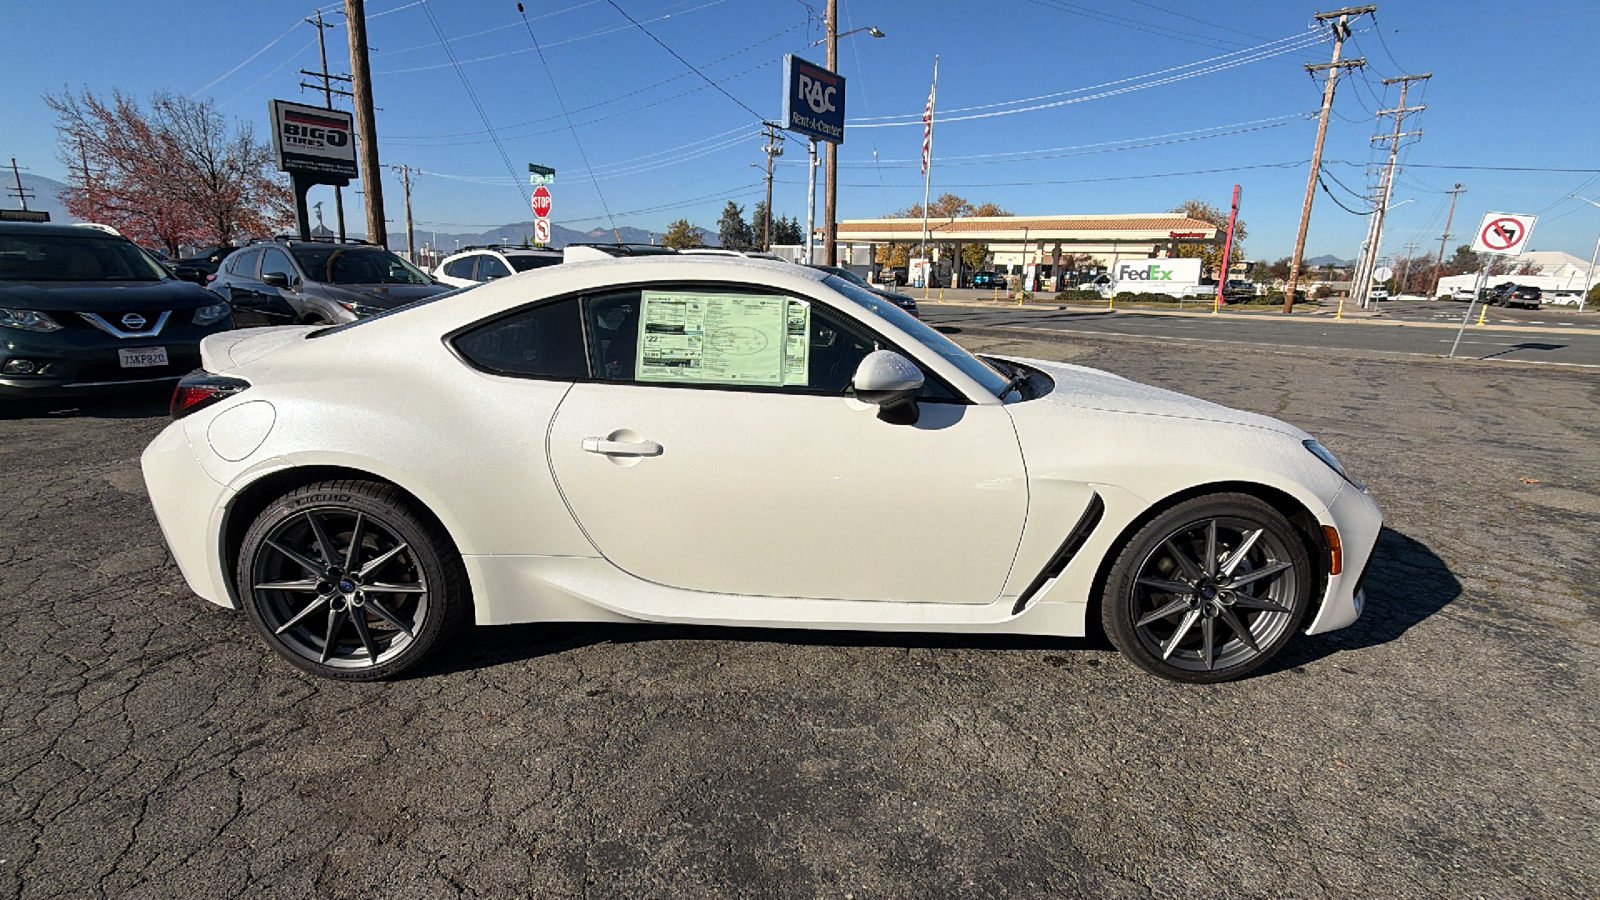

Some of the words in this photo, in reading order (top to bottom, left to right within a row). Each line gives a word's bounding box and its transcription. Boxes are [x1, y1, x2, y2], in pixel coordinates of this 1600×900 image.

[798, 73, 837, 114] RAC
[283, 123, 326, 140] BIG
[283, 135, 326, 147] TIRES
[532, 196, 550, 209] STOP
[1168, 231, 1206, 239] Speedway
[1119, 264, 1174, 281] FedEx
[123, 353, 166, 365] 7SKP820
[300, 494, 351, 505] MICHELIN
